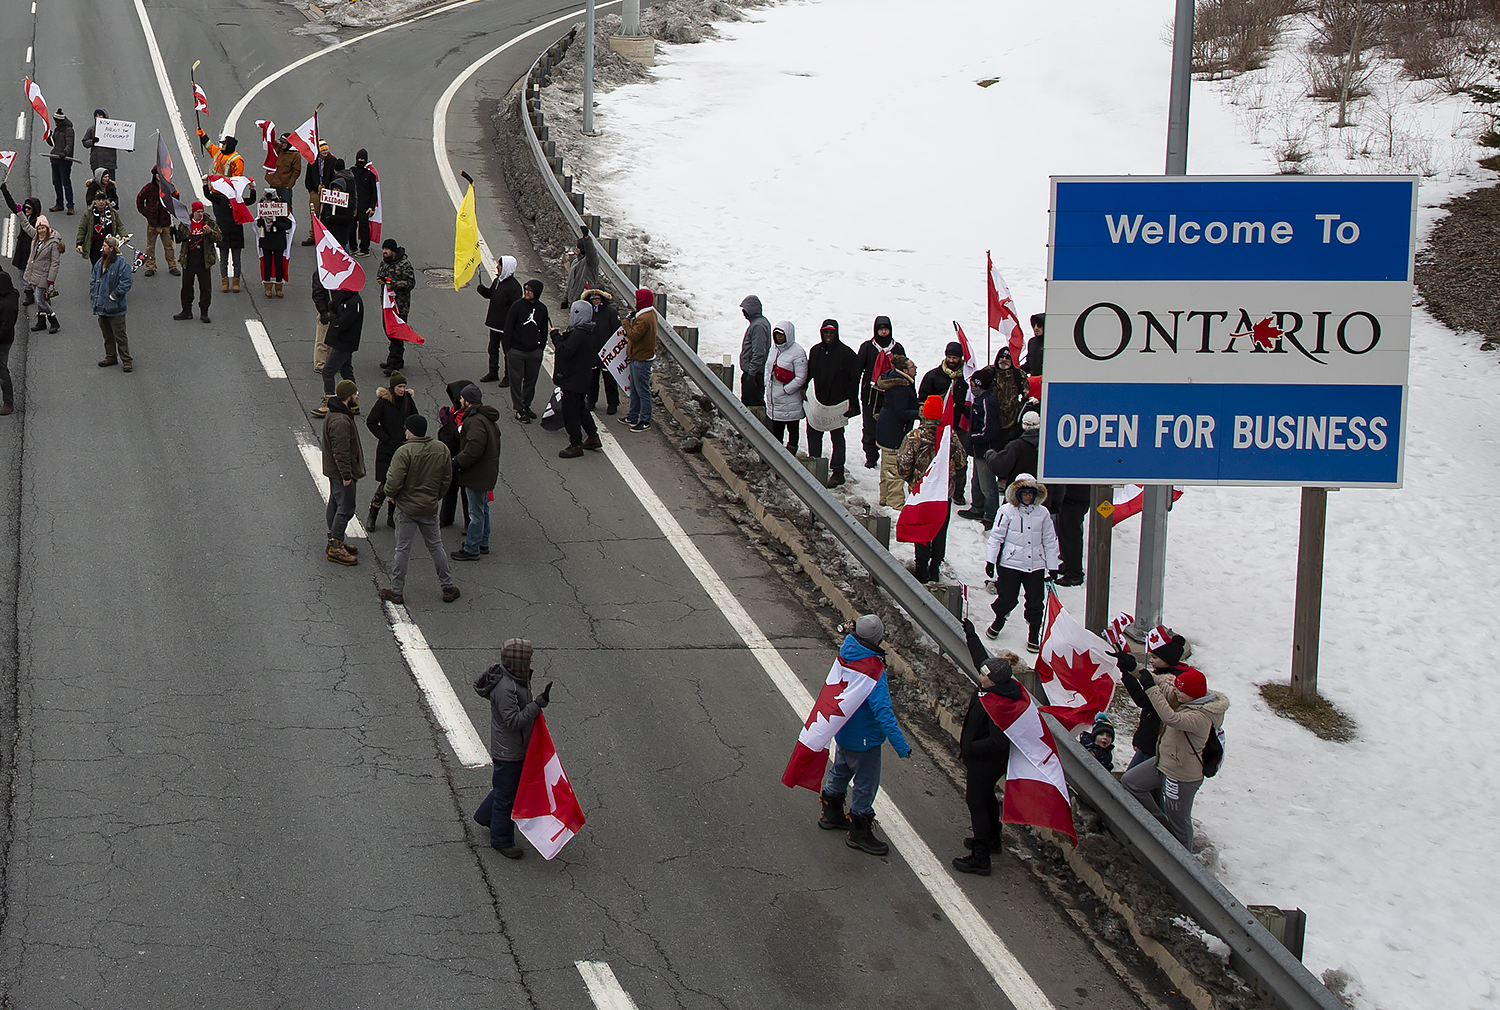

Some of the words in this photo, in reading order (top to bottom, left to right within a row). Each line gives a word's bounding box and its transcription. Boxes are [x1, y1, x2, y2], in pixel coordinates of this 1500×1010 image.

[1105, 214, 1294, 245] Welcome
[1315, 214, 1361, 245] To
[1073, 301, 1382, 365] ONTARIO
[602, 337, 629, 367] TRUDEA
[616, 356, 631, 375] MUS
[1057, 413, 1139, 449] OPEN
[1154, 414, 1216, 449] FOR
[1232, 414, 1388, 451] BUSINESS
